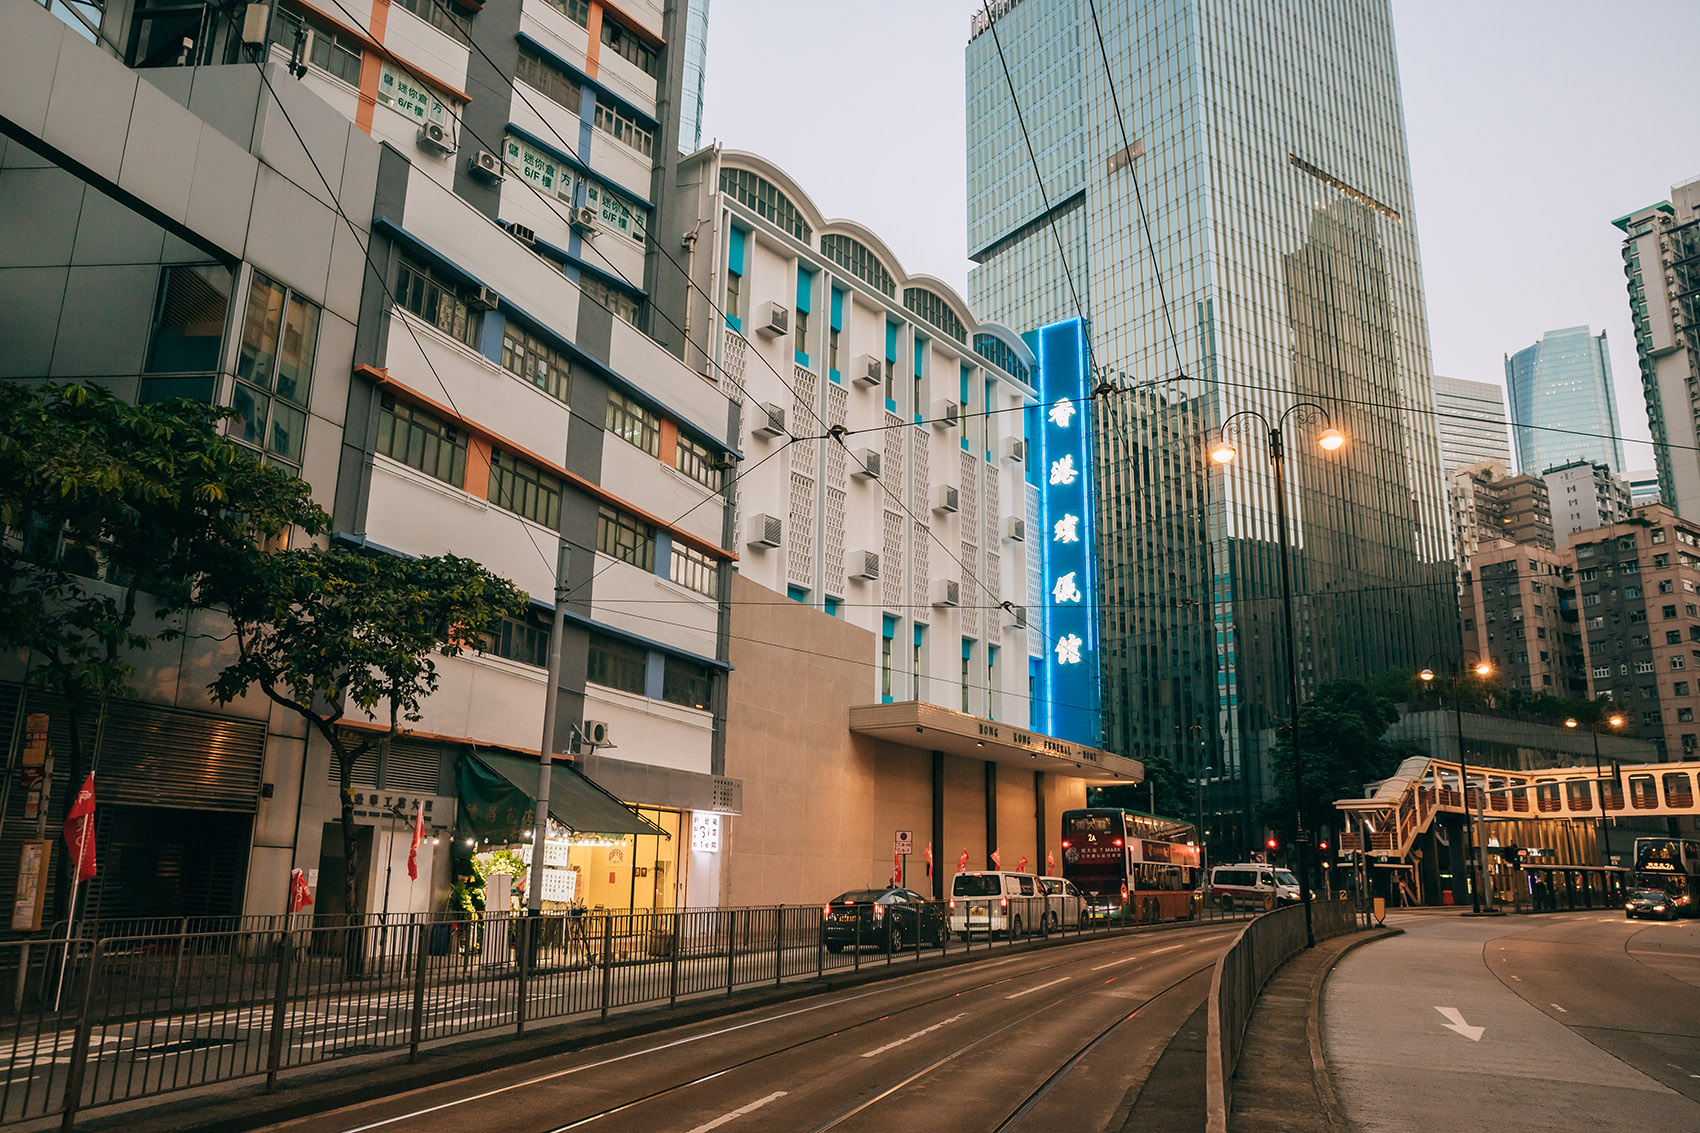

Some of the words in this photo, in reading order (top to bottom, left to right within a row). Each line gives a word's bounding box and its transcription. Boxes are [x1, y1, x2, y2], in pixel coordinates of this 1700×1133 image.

[397, 81, 428, 105] 迷你倉
[433, 101, 442, 114] 方
[397, 97, 413, 110] 6/F
[414, 104, 424, 118] 樓
[523, 151, 555, 178] 迷你倉
[561, 172, 571, 187] 方
[524, 166, 541, 181] 6/F
[541, 175, 552, 190] 樓
[602, 209, 617, 223] 6/F
[1047, 397, 1082, 666] 香港殯儀館
[978, 723, 999, 738] HONG
[1013, 732, 1031, 746] KONG
[1044, 740, 1072, 756] FUNERAL
[1087, 833, 1097, 842] 2A
[1664, 862, 1675, 871] 2A
